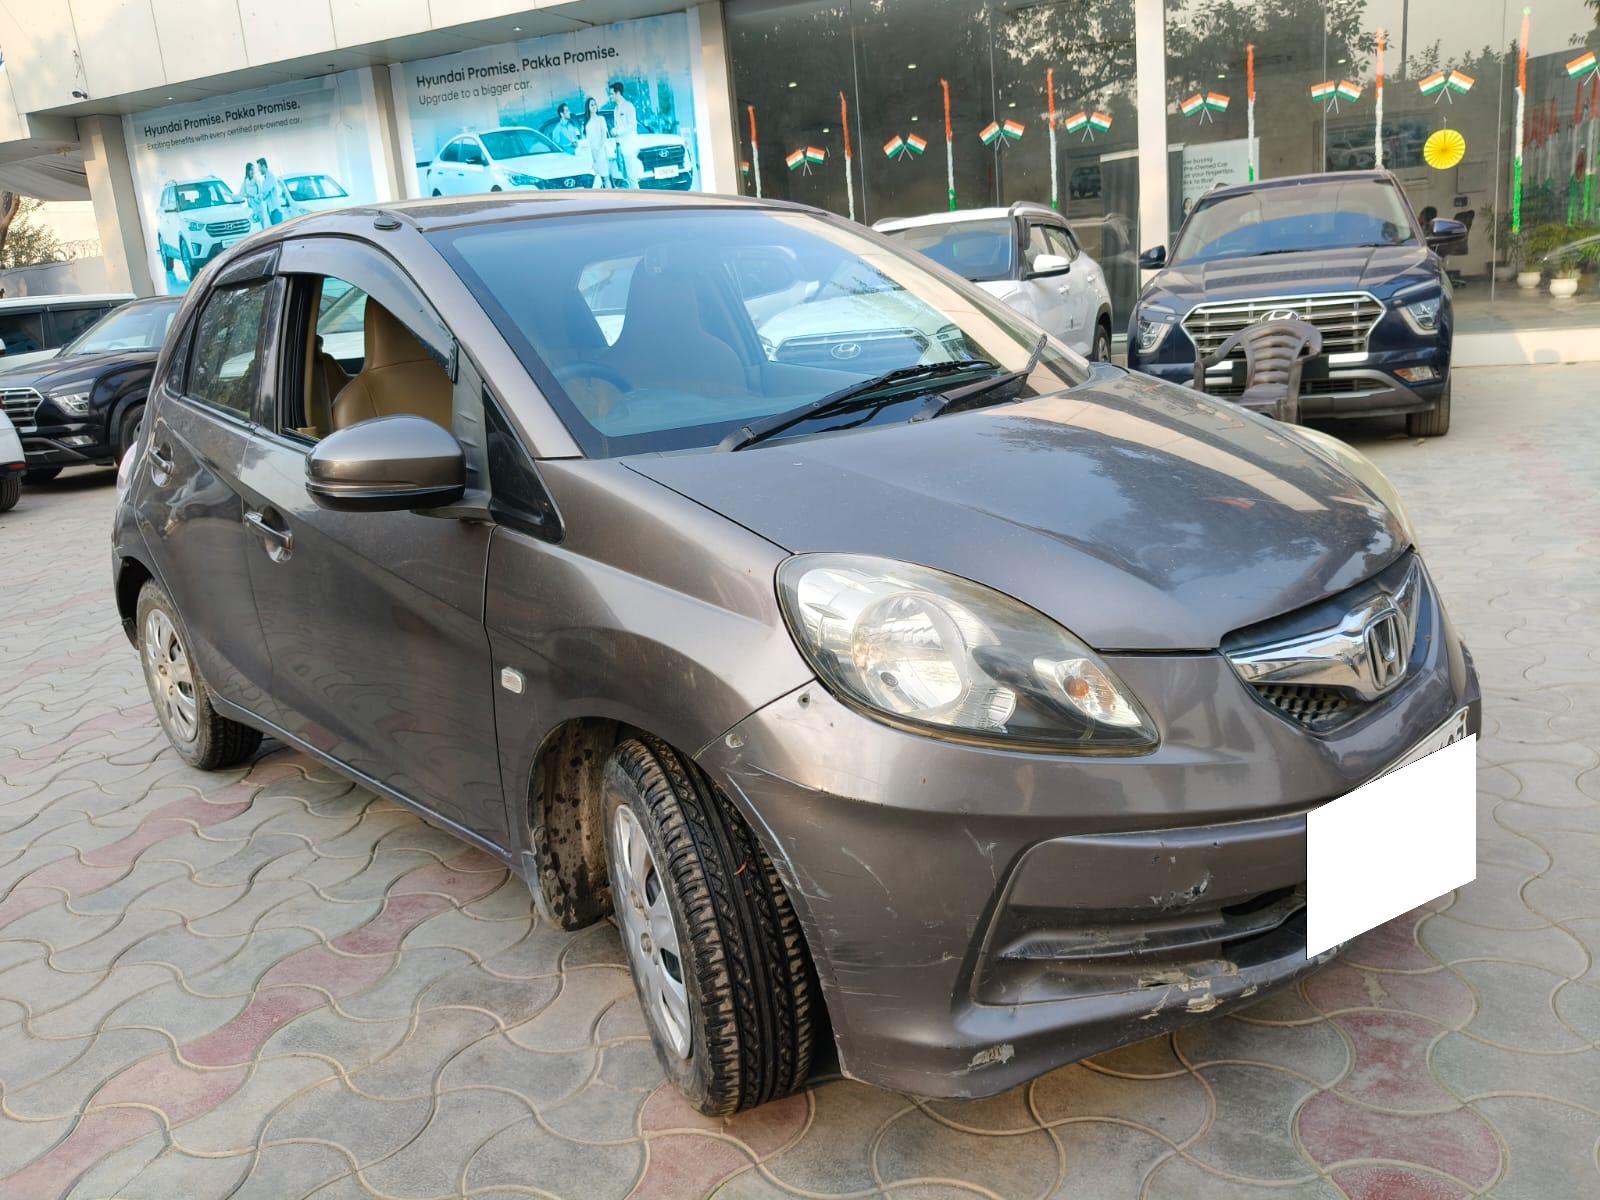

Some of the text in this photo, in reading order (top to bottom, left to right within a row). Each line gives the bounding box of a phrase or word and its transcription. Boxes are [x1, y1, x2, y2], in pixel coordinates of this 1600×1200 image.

[416, 45, 620, 90] Hyundai Promise. Pakka Promise.
[418, 79, 533, 106] Upgrade to a bigger car.
[144, 99, 300, 138] Hyundai Promise. Pakka Promise.
[147, 117, 303, 151] Exciting benefits with every certified pre-owned car.
